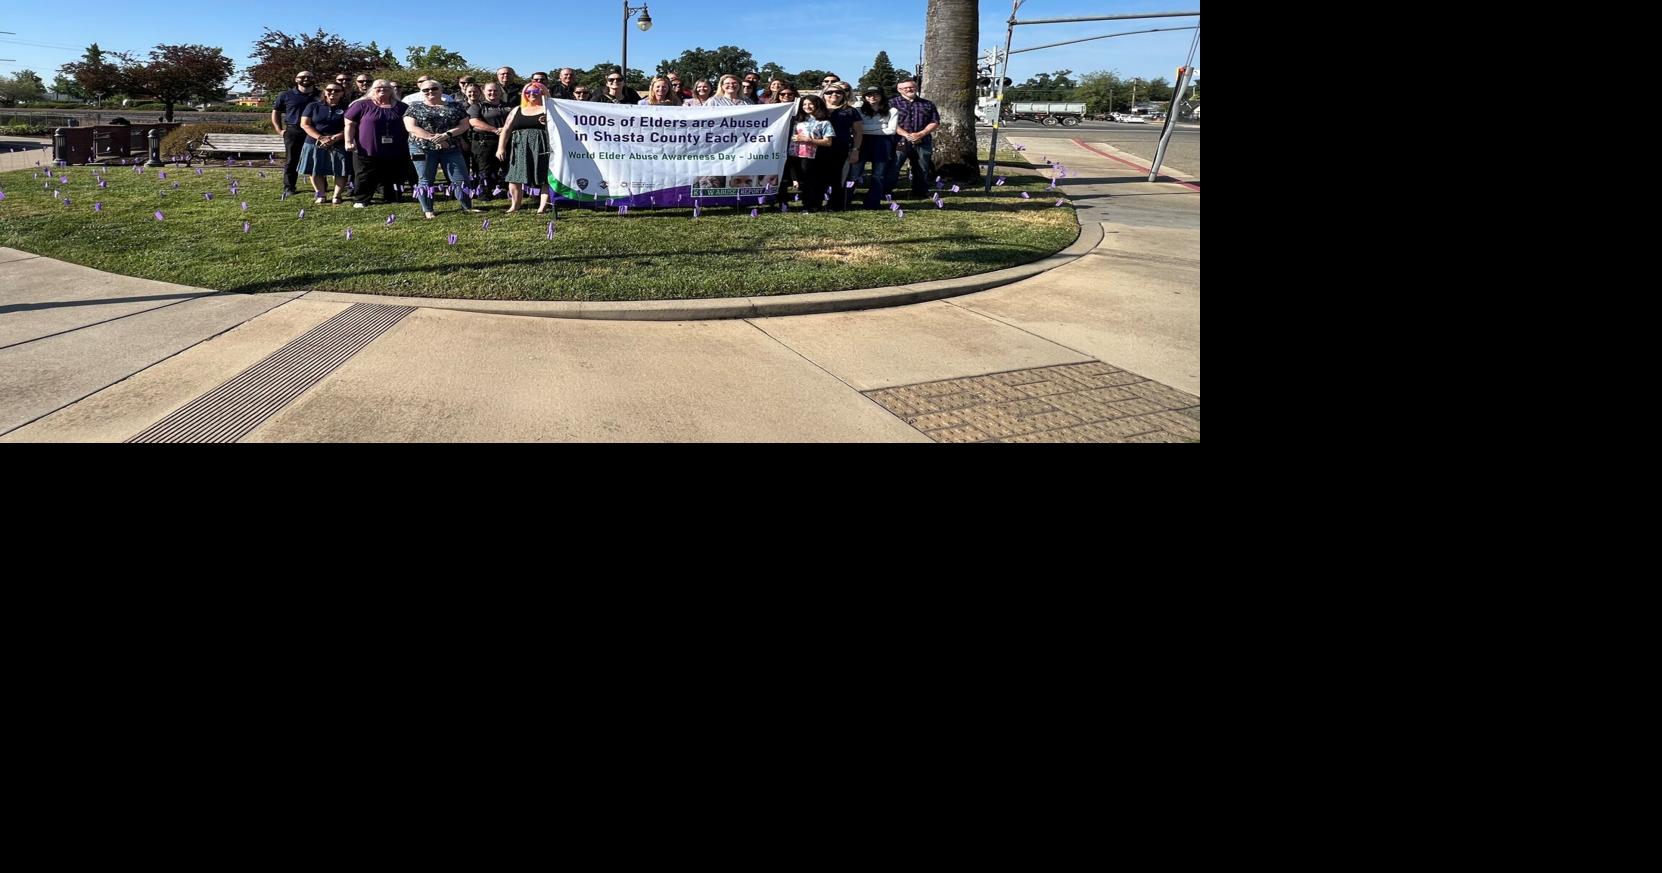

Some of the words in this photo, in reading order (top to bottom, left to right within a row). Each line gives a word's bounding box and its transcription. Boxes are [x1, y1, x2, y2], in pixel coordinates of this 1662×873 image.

[573, 115, 615, 127] 1000s
[620, 116, 635, 127] of
[640, 116, 687, 128] Elders
[691, 119, 715, 128] are
[719, 117, 769, 128] Abused
[575, 130, 588, 142] in
[593, 130, 645, 143] Shasta
[650, 132, 701, 146] County
[705, 132, 738, 143] Each
[742, 132, 774, 143] Year
[568, 151, 596, 160] World
[599, 151, 626, 160] Elder
[629, 152, 659, 161] Abuse
[661, 152, 716, 161] Awareness
[718, 152, 736, 162] Day
[747, 152, 769, 161] June
[771, 152, 780, 160] 15
